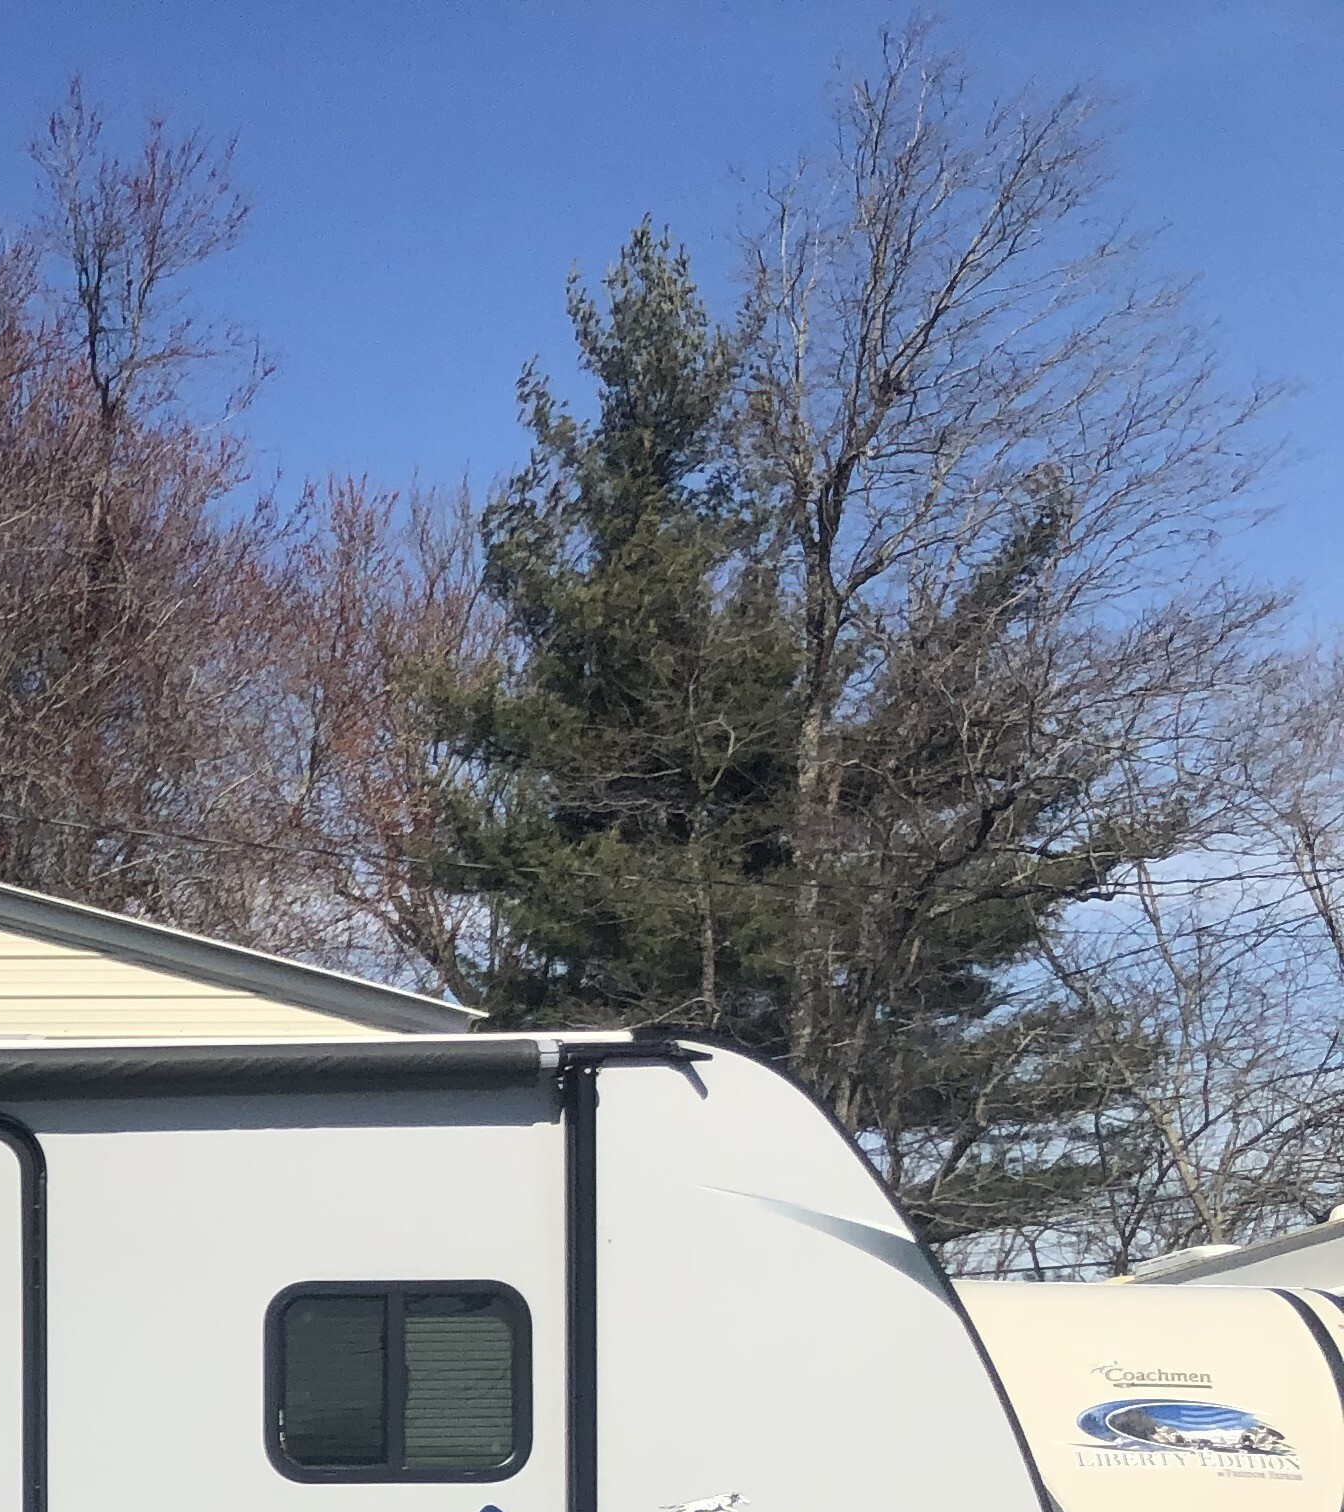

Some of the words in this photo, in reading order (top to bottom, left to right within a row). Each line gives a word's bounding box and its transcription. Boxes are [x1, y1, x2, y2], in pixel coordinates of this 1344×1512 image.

[1105, 1368, 1212, 1383] Coachmen
[1075, 1451, 1187, 1467] LIBERTY
[1200, 1451, 1301, 1470] EDITION
